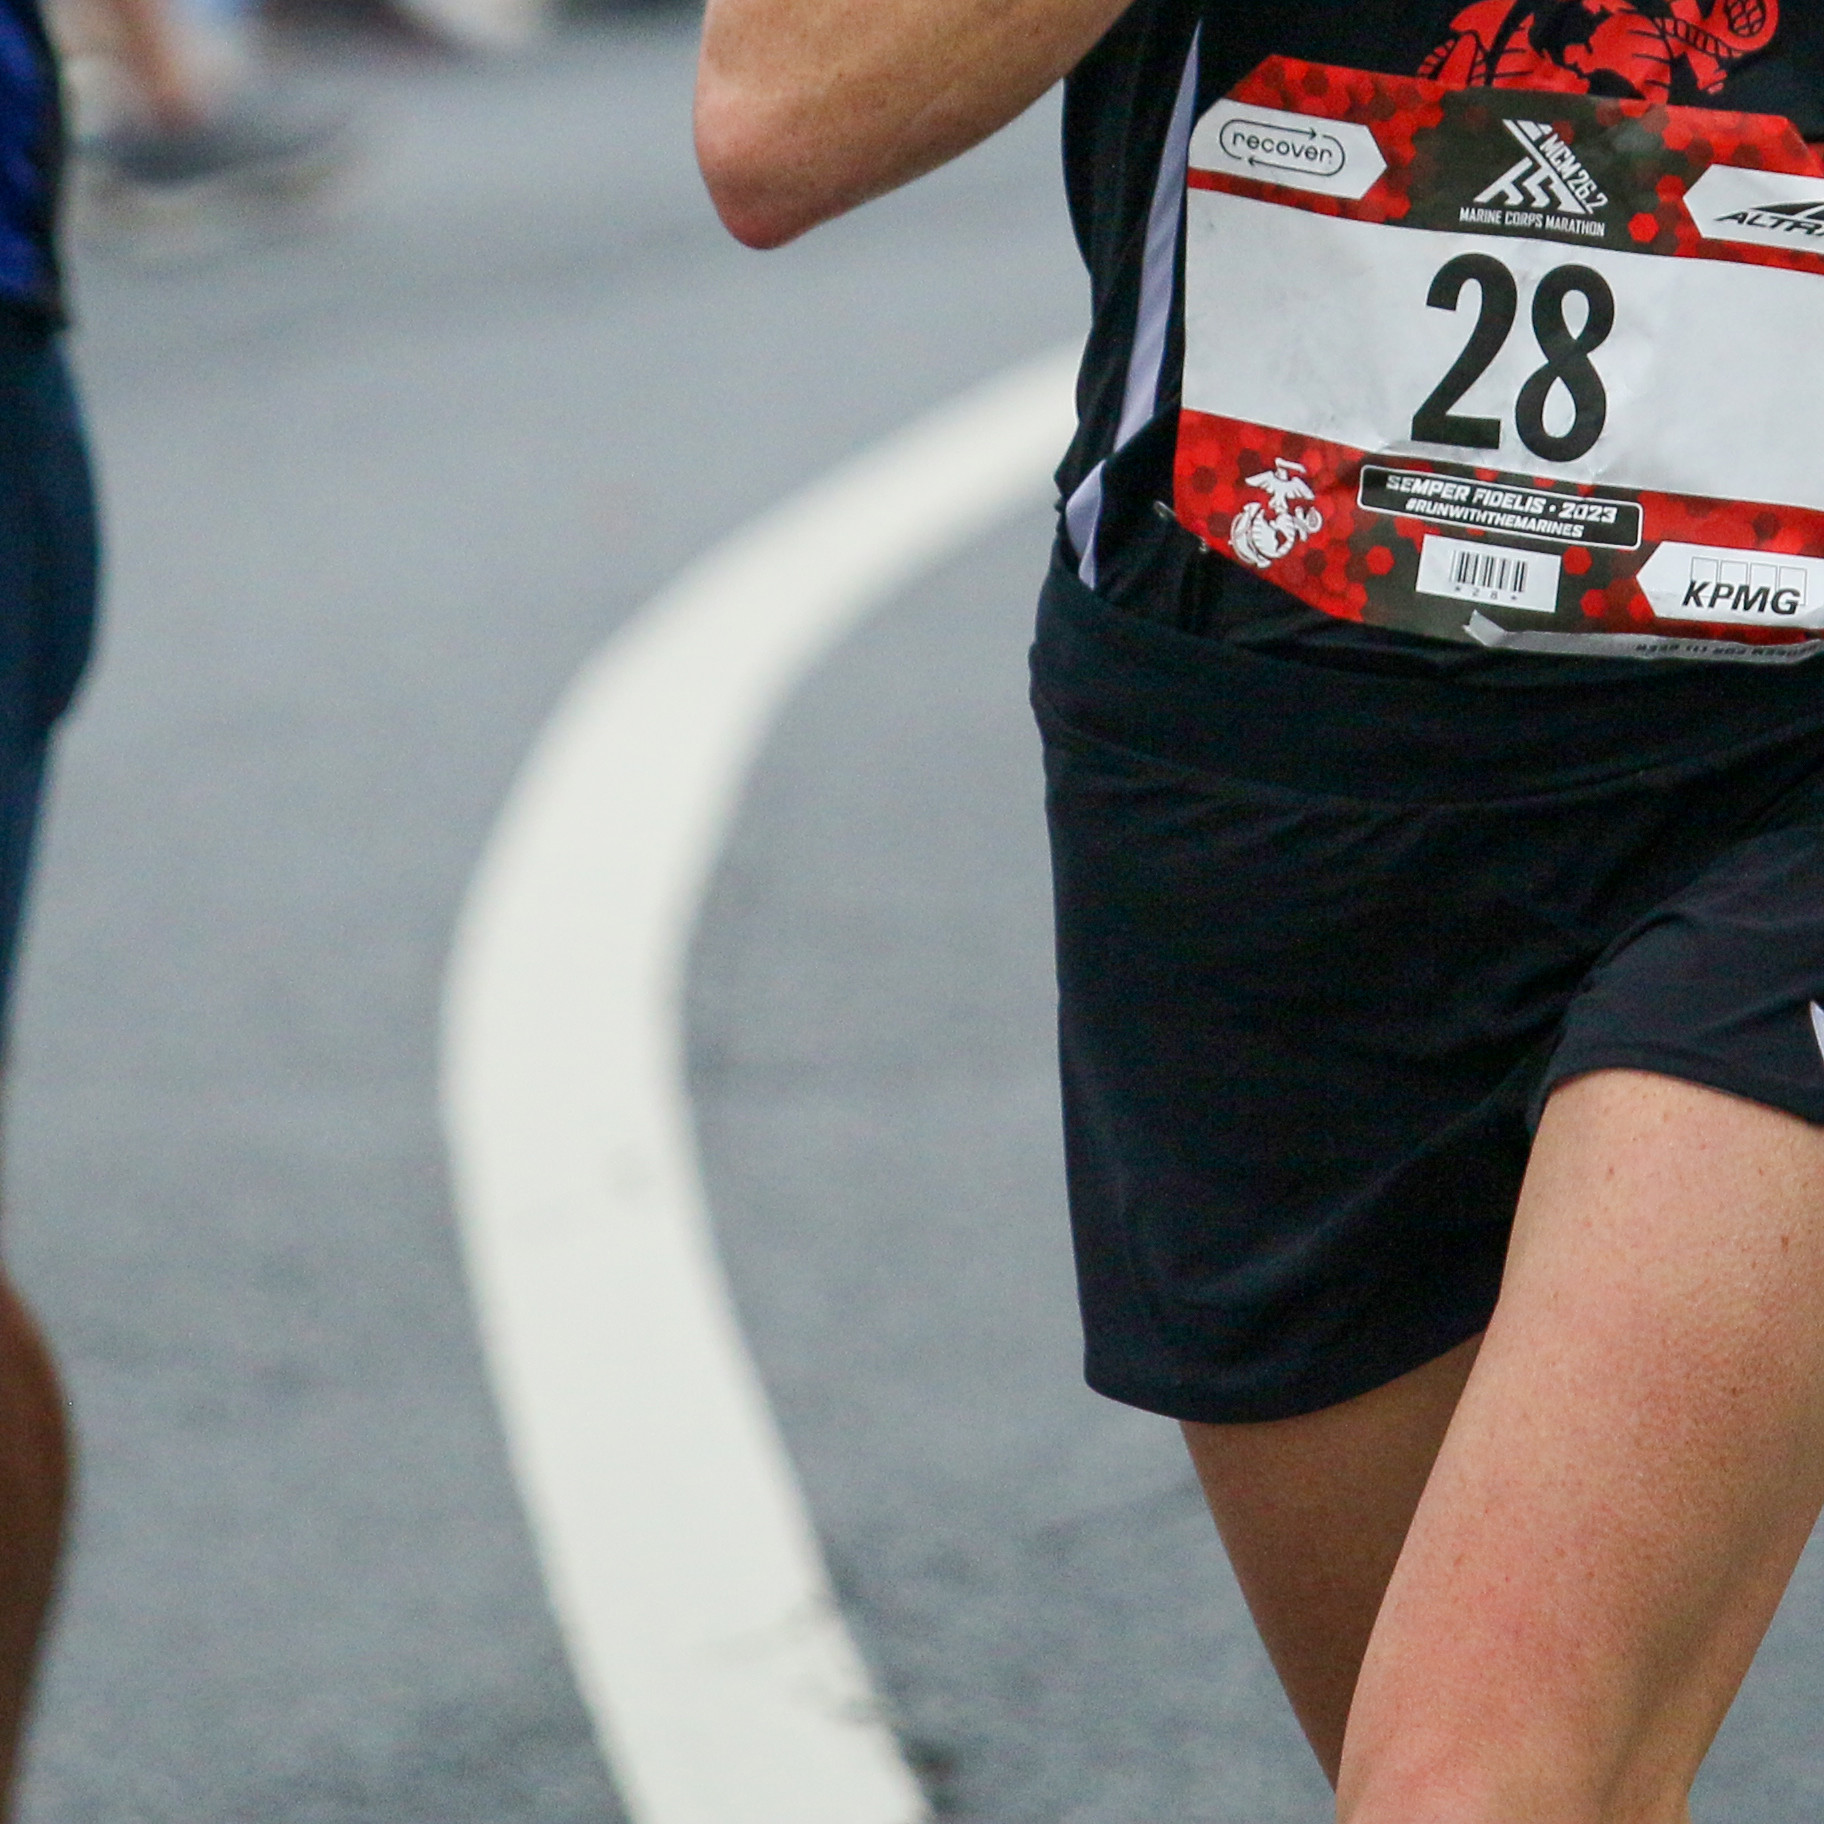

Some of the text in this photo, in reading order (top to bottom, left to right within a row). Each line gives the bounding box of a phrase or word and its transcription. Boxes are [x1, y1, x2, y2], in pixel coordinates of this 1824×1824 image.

[1231, 131, 1333, 162] recover
[1539, 133, 1609, 215] MCM 26.2
[1459, 207, 1606, 237] MARINE CORPS MARATHON
[1411, 252, 1616, 462] 28
[1385, 474, 1618, 524] SEMPER FIDELIS 2023
[1405, 499, 1585, 539] #RUNWITHTHEMARINES
[1682, 578, 1801, 615] KPMG
